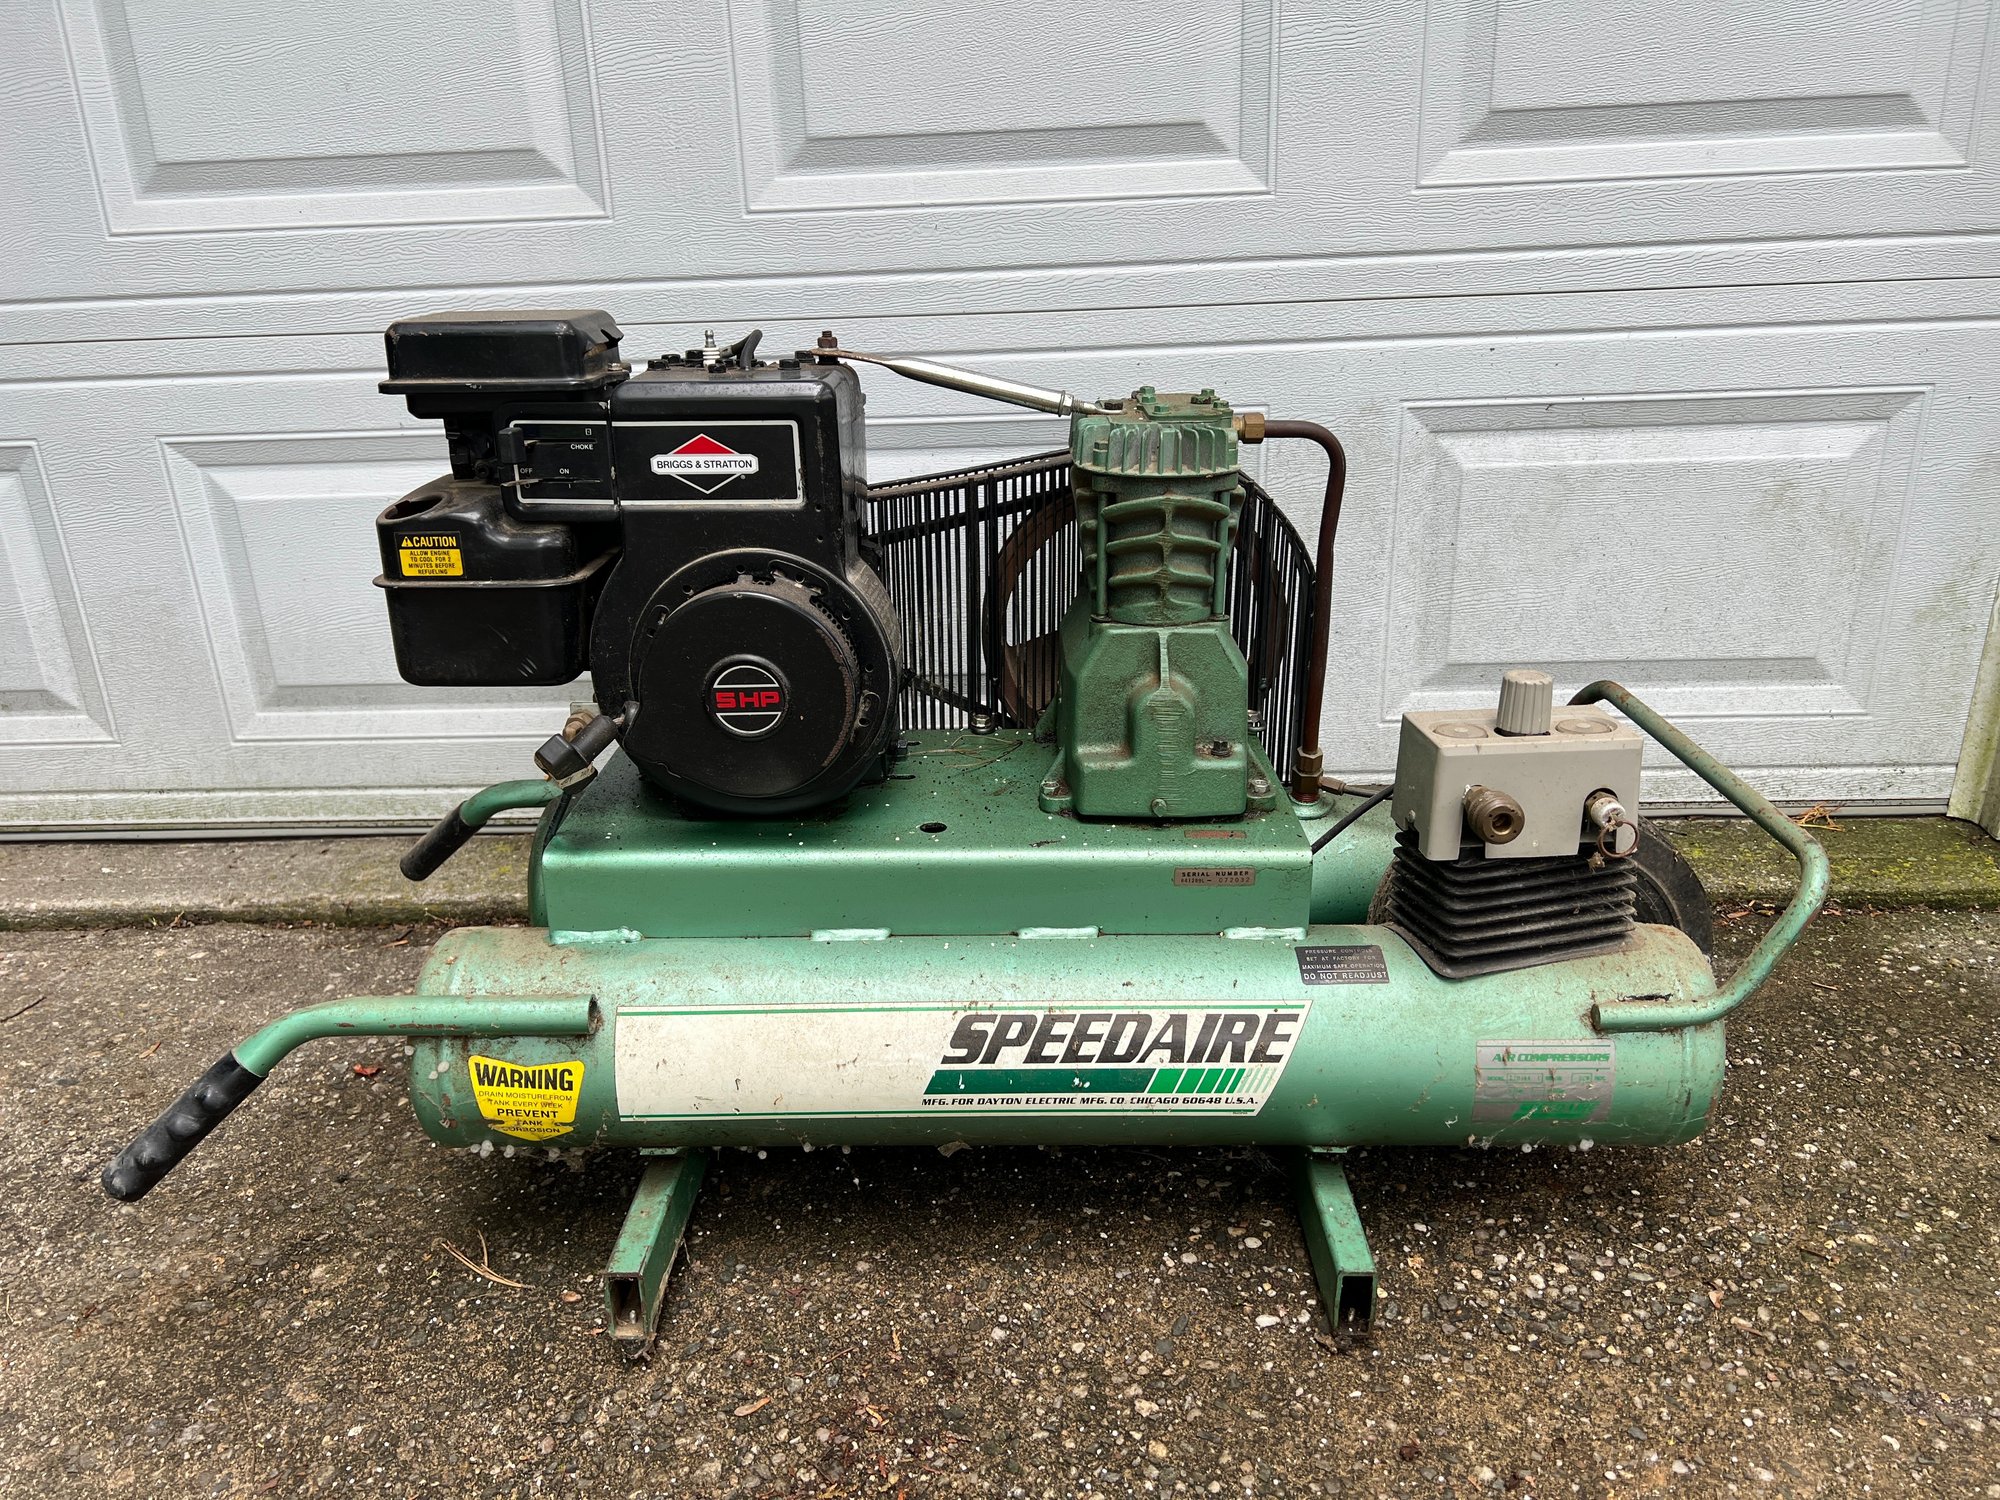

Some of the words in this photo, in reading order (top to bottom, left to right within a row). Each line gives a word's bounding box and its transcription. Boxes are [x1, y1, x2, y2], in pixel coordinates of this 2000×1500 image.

[656, 460, 693, 469] BRIGGS
[695, 460, 702, 469] &
[703, 459, 753, 469] STRATTON
[412, 536, 457, 548] CAUTION
[715, 692, 737, 708] 5
[739, 691, 780, 708] HP
[1303, 972, 1317, 980] DO
[1320, 972, 1338, 980] NOT
[1342, 971, 1387, 979] READJUST
[940, 1013, 1300, 1064] SPEEDAIRE
[1517, 1053, 1611, 1062] COMPRESSORS
[474, 1062, 574, 1092] WARNING
[478, 1090, 504, 1098] DRAIN
[505, 1092, 549, 1100] MOISTURE
[487, 1098, 510, 1106] TANK
[540, 1101, 563, 1109] WEEK
[921, 1098, 949, 1106] MFG.
[977, 1097, 1022, 1105] DAYTON
[1025, 1097, 1076, 1105] ELECTRIC
[1079, 1097, 1107, 1105] MFG.
[1130, 1097, 1179, 1105] CHICAGO
[1182, 1097, 1222, 1105] 60648
[1225, 1096, 1258, 1104] U.S.A.
[496, 1108, 559, 1119] PREVENT
